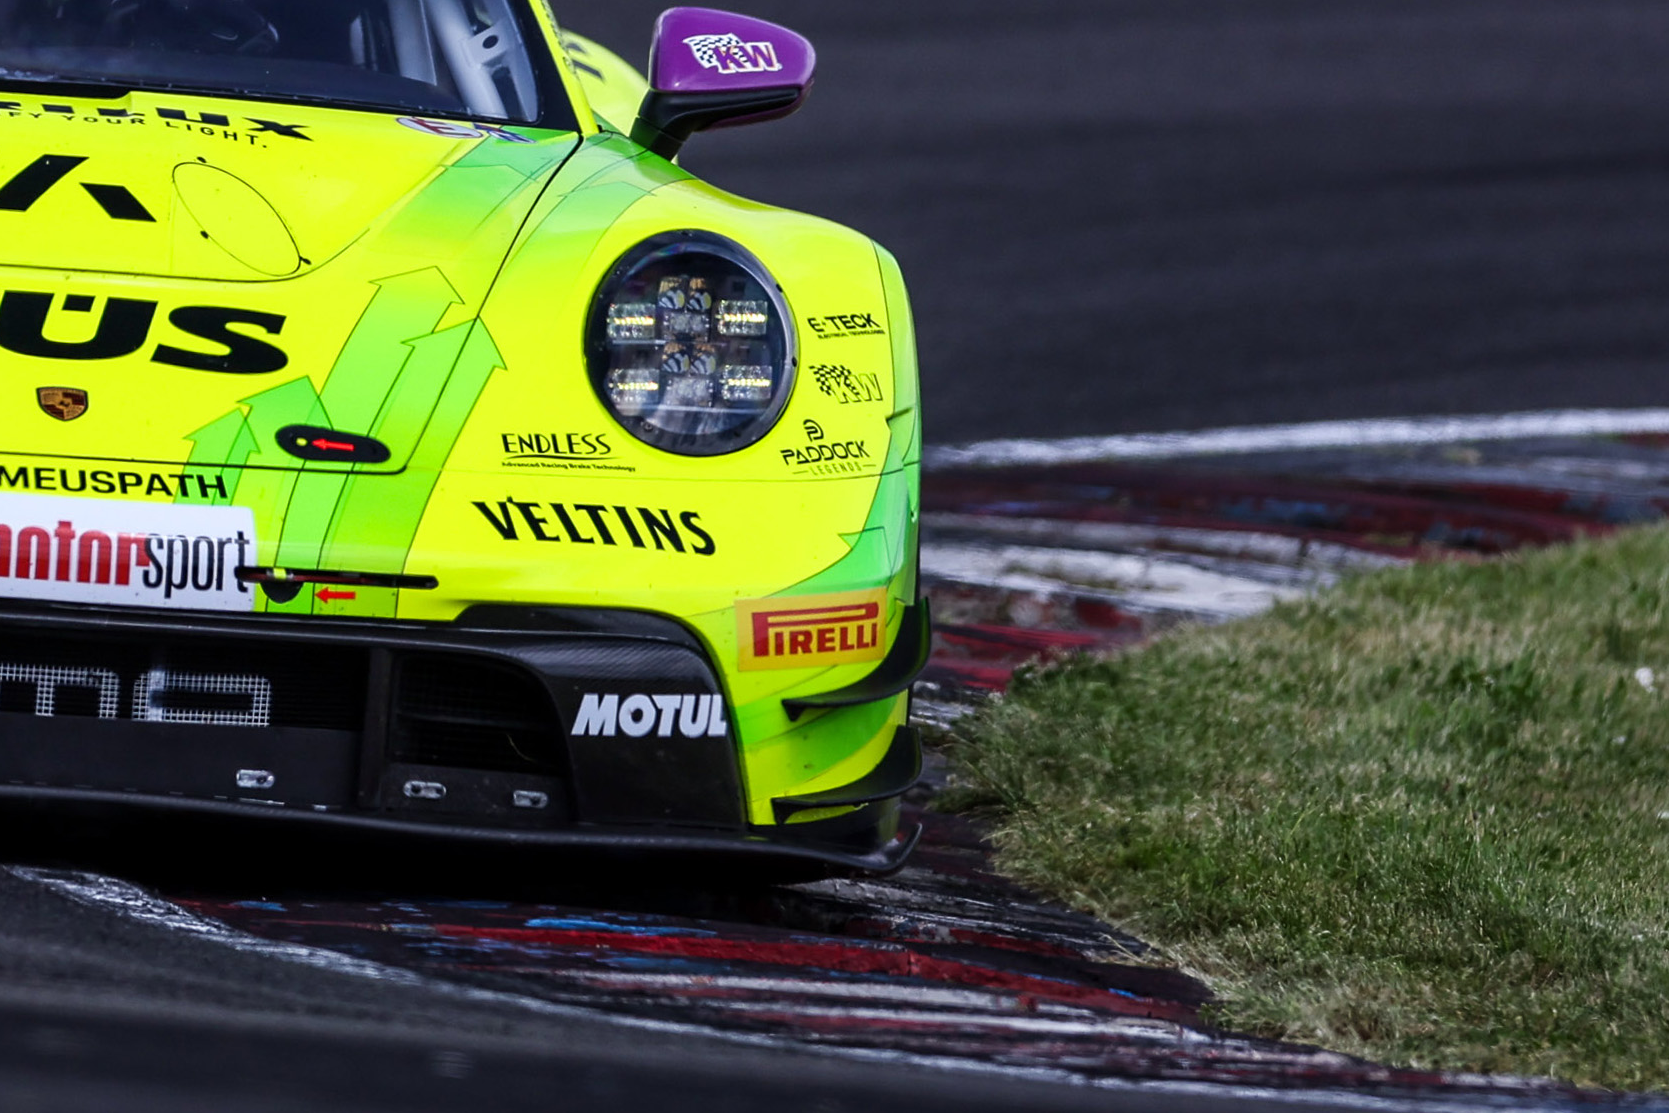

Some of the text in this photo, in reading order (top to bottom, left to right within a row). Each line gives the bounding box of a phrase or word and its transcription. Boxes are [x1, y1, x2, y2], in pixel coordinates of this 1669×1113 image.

[711, 42, 782, 74] KW
[61, 114, 147, 126] YOUR
[166, 120, 268, 149] LIGHT.
[829, 372, 883, 405] KW
[501, 433, 612, 455] ENDLESS
[780, 440, 871, 466] PADDOCK
[809, 461, 863, 476] LEGENDS
[470, 496, 716, 556] VELTINS
[751, 601, 880, 658] PIRELLI
[570, 692, 728, 738] MOTUL
